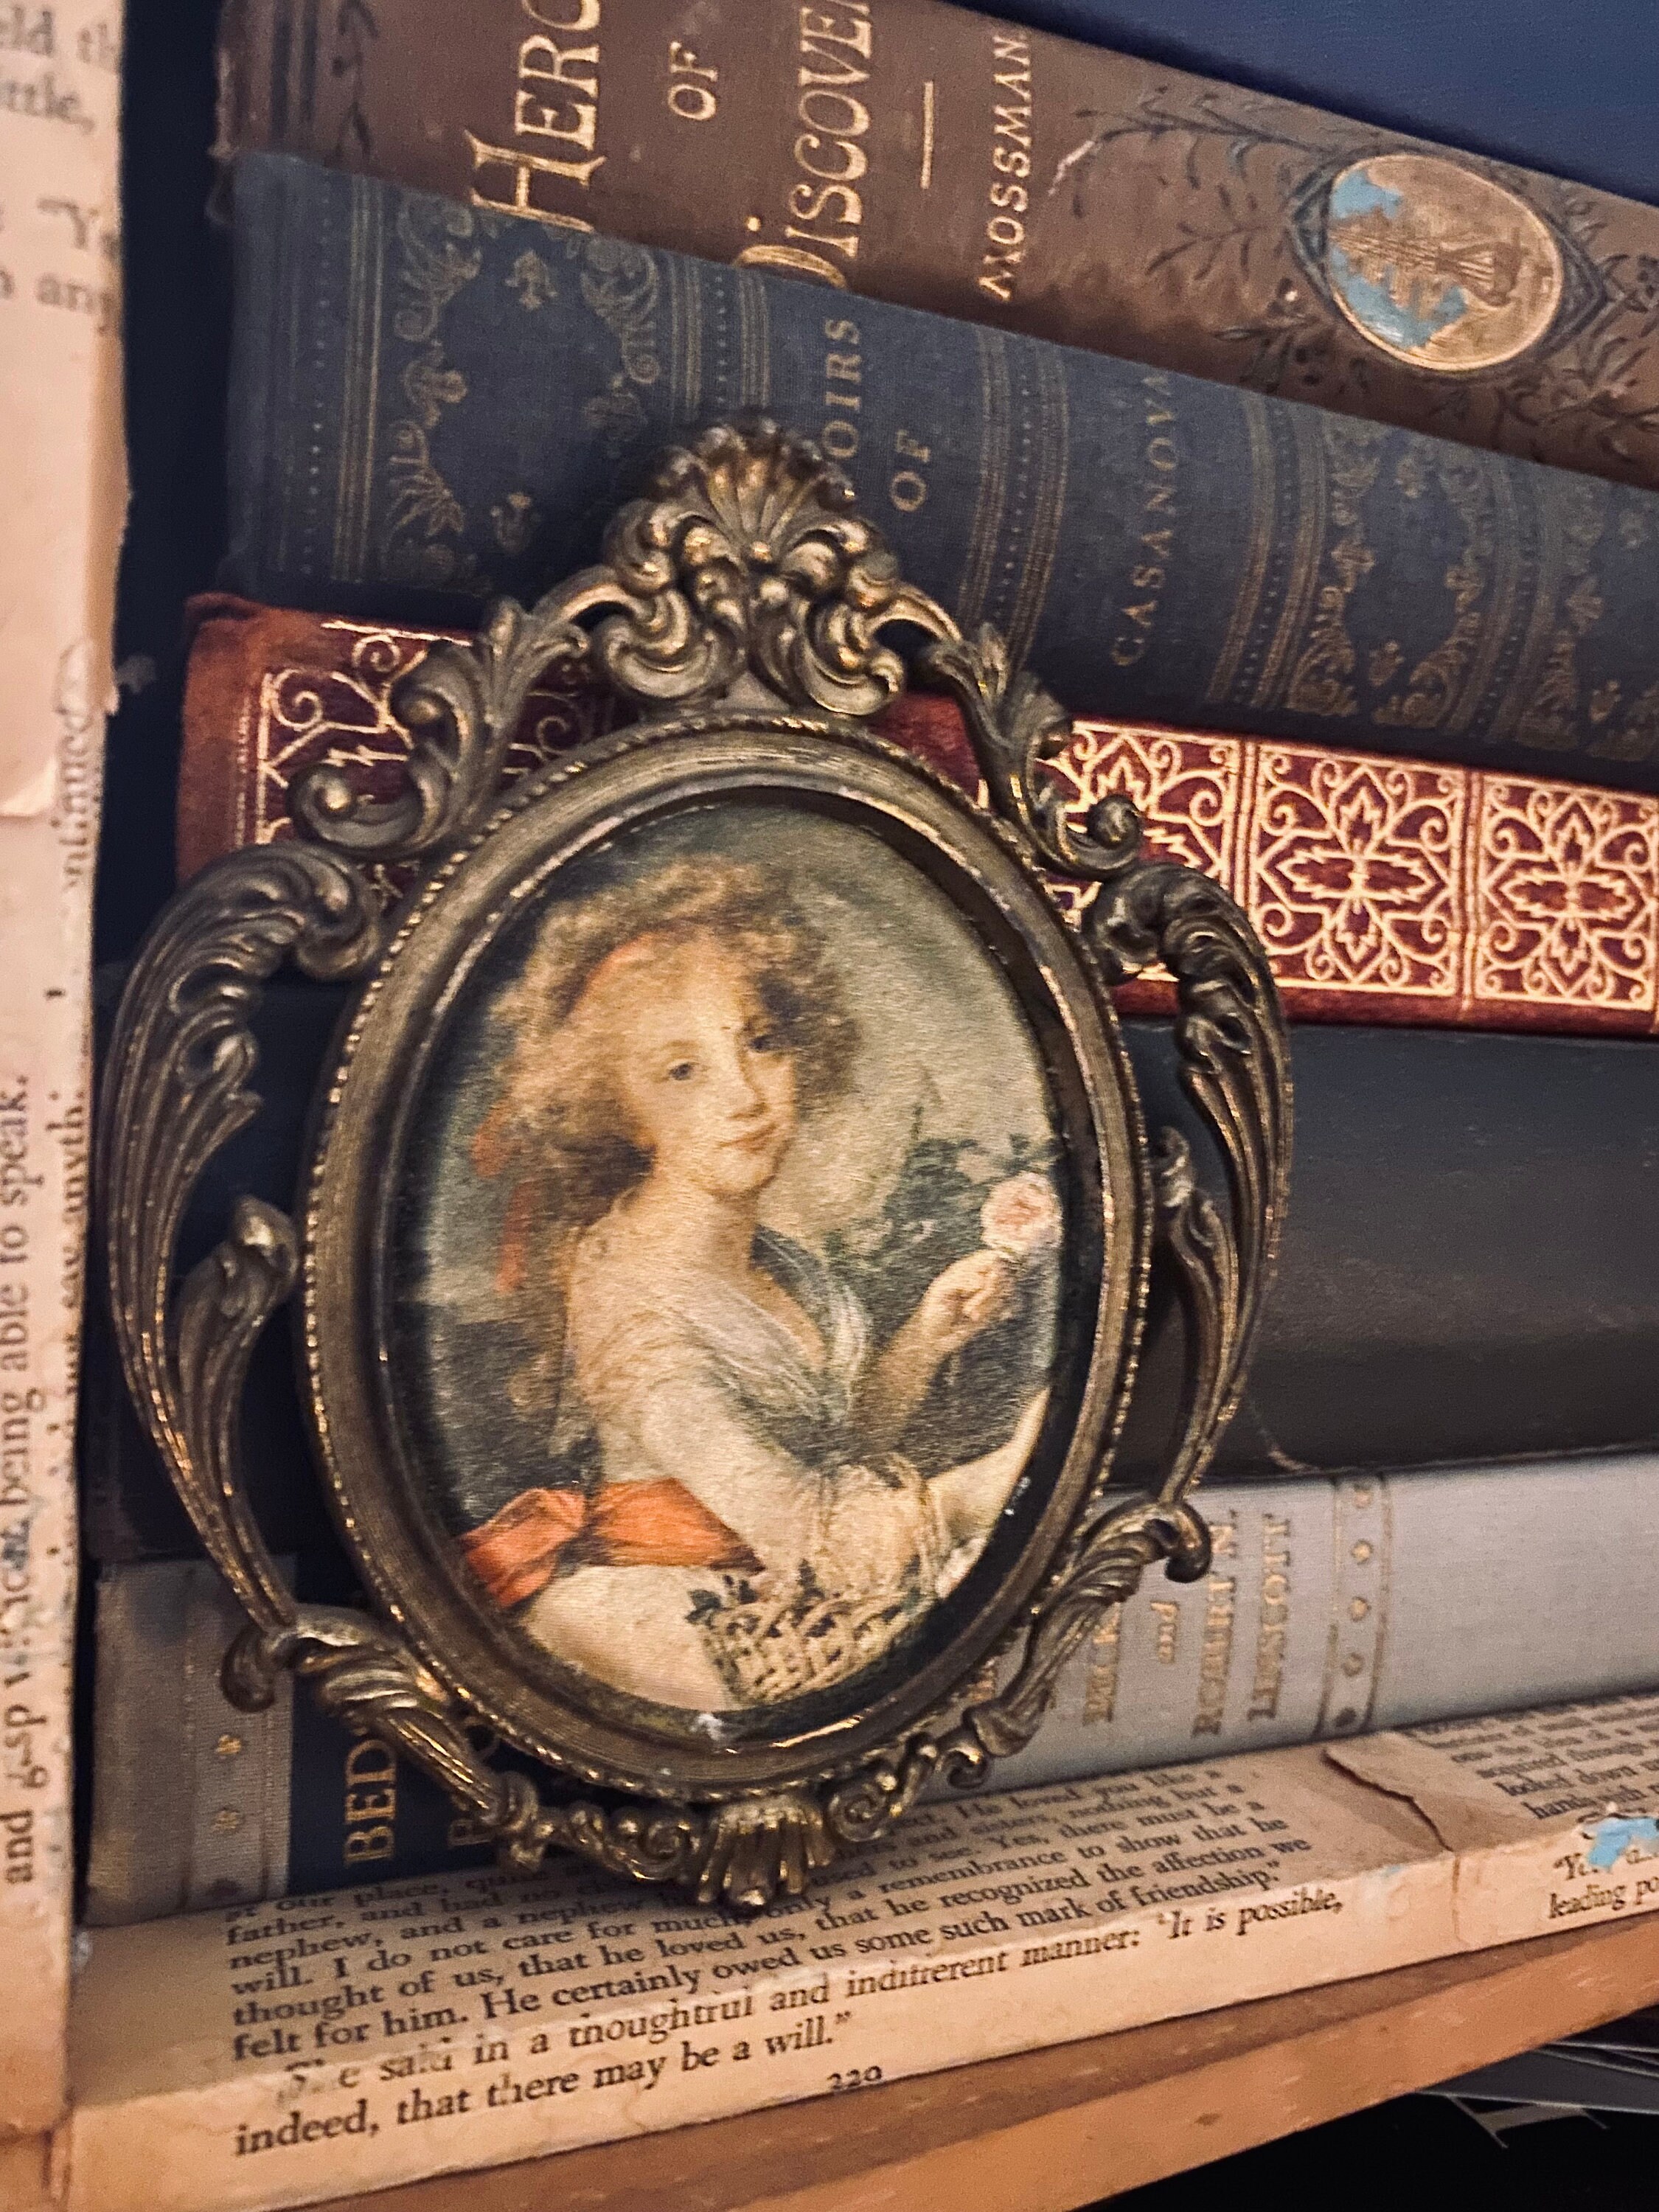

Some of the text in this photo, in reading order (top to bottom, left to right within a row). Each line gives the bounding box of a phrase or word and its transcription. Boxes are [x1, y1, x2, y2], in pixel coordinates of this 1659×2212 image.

[668, 41, 719, 122] OF
[736, 0, 873, 289] DISCOVE
[978, 34, 1032, 302] MOSSMAN
[821, 318, 863, 460] OIRS
[890, 428, 932, 512] OF
[1110, 372, 1177, 666] CASANOVA
[0, 1809, 34, 1885] and
[227, 1917, 346, 1947] father,
[359, 1902, 426, 1921] and
[1068, 1795, 1172, 1819] nothing
[1170, 1787, 1220, 1800] but
[344, 1739, 398, 1867] BED
[230, 1933, 383, 1970] nephew,
[400, 1917, 465, 1939] and
[483, 1917, 502, 1929] a
[888, 1856, 919, 1871] to
[1057, 1821, 1129, 1839] there
[1136, 1809, 1200, 1826] must
[1200, 1801, 1242, 1815] be
[1245, 1801, 1266, 1812] a
[230, 1964, 315, 1995] will.
[334, 1956, 352, 1979] I
[366, 1949, 414, 1972] do
[429, 1940, 489, 1961] not
[503, 1930, 577, 1950] care
[587, 1921, 636, 1940] for
[846, 1889, 867, 1902] a
[877, 1852, 1068, 1894] remembrance
[1077, 1844, 1107, 1860] to
[1116, 1833, 1181, 1854] show
[1192, 1823, 1248, 1843] that
[1245, 1816, 1290, 1832] he
[233, 1838, 1314, 2026] thought of us, that he loved us, that he recognized the affection we
[1547, 1883, 1627, 1919] leading
[232, 2031, 302, 2062] felt
[314, 2020, 370, 2048] for
[382, 2007, 470, 2037] him.
[479, 1988, 543, 2020] He
[552, 1963, 705, 2008] certainly
[712, 1946, 803, 1979] owed
[809, 1941, 849, 1961] us
[855, 1928, 931, 1954] some
[941, 1910, 1010, 1941] such
[1019, 1898, 1092, 1930] mark
[1095, 1886, 1130, 1915] of
[473, 2033, 510, 2065] in
[529, 2031, 552, 2055] a
[769, 1972, 831, 2011] and
[1019, 1927, 1141, 1969] manner:
[1206, 1907, 1227, 1933] is
[1236, 1886, 1343, 1937] possible,
[234, 2098, 382, 2157] indeed,
[396, 2086, 473, 2126] that
[487, 2067, 581, 2109] there
[592, 2056, 668, 2090] may
[681, 2039, 720, 2072] be
[732, 2038, 751, 2061] a
[826, 2064, 883, 2090] 220
